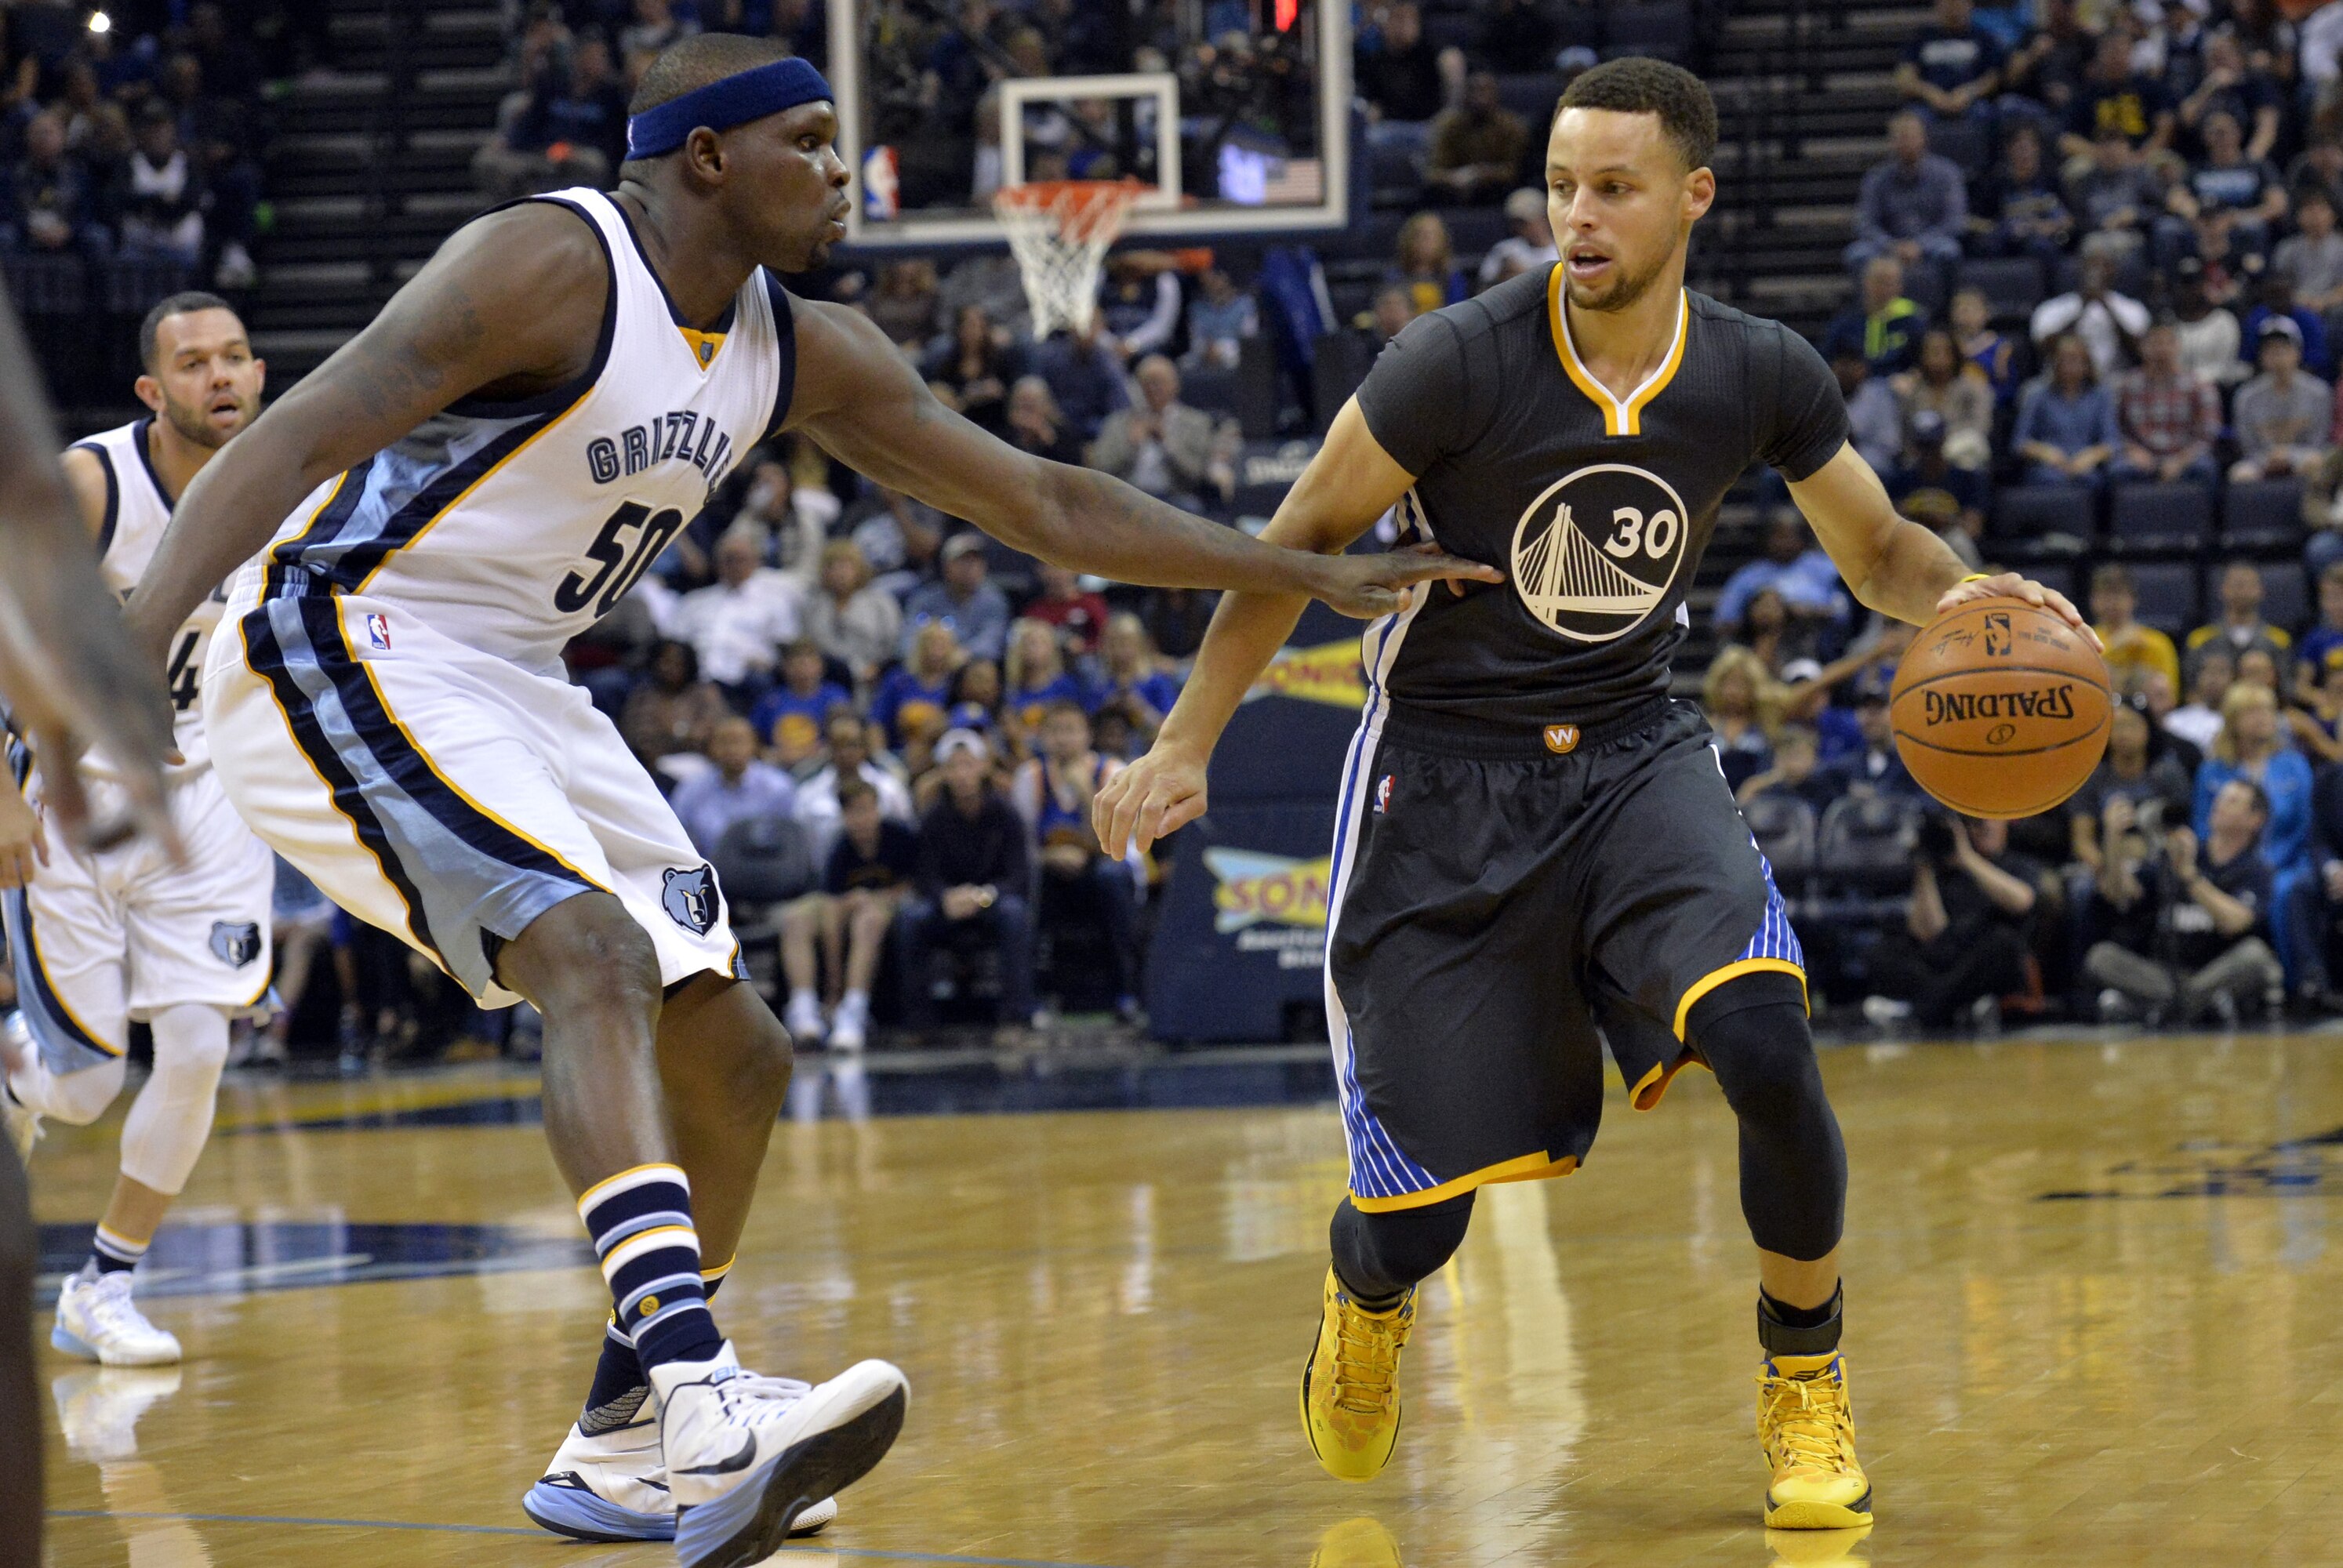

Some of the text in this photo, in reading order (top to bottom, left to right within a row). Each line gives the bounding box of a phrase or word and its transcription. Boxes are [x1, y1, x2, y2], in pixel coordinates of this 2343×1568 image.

[1603, 506, 1678, 559] 30
[554, 500, 684, 619] 50
[1925, 684, 2074, 727] SPALDING
[1547, 727, 1574, 746] W
